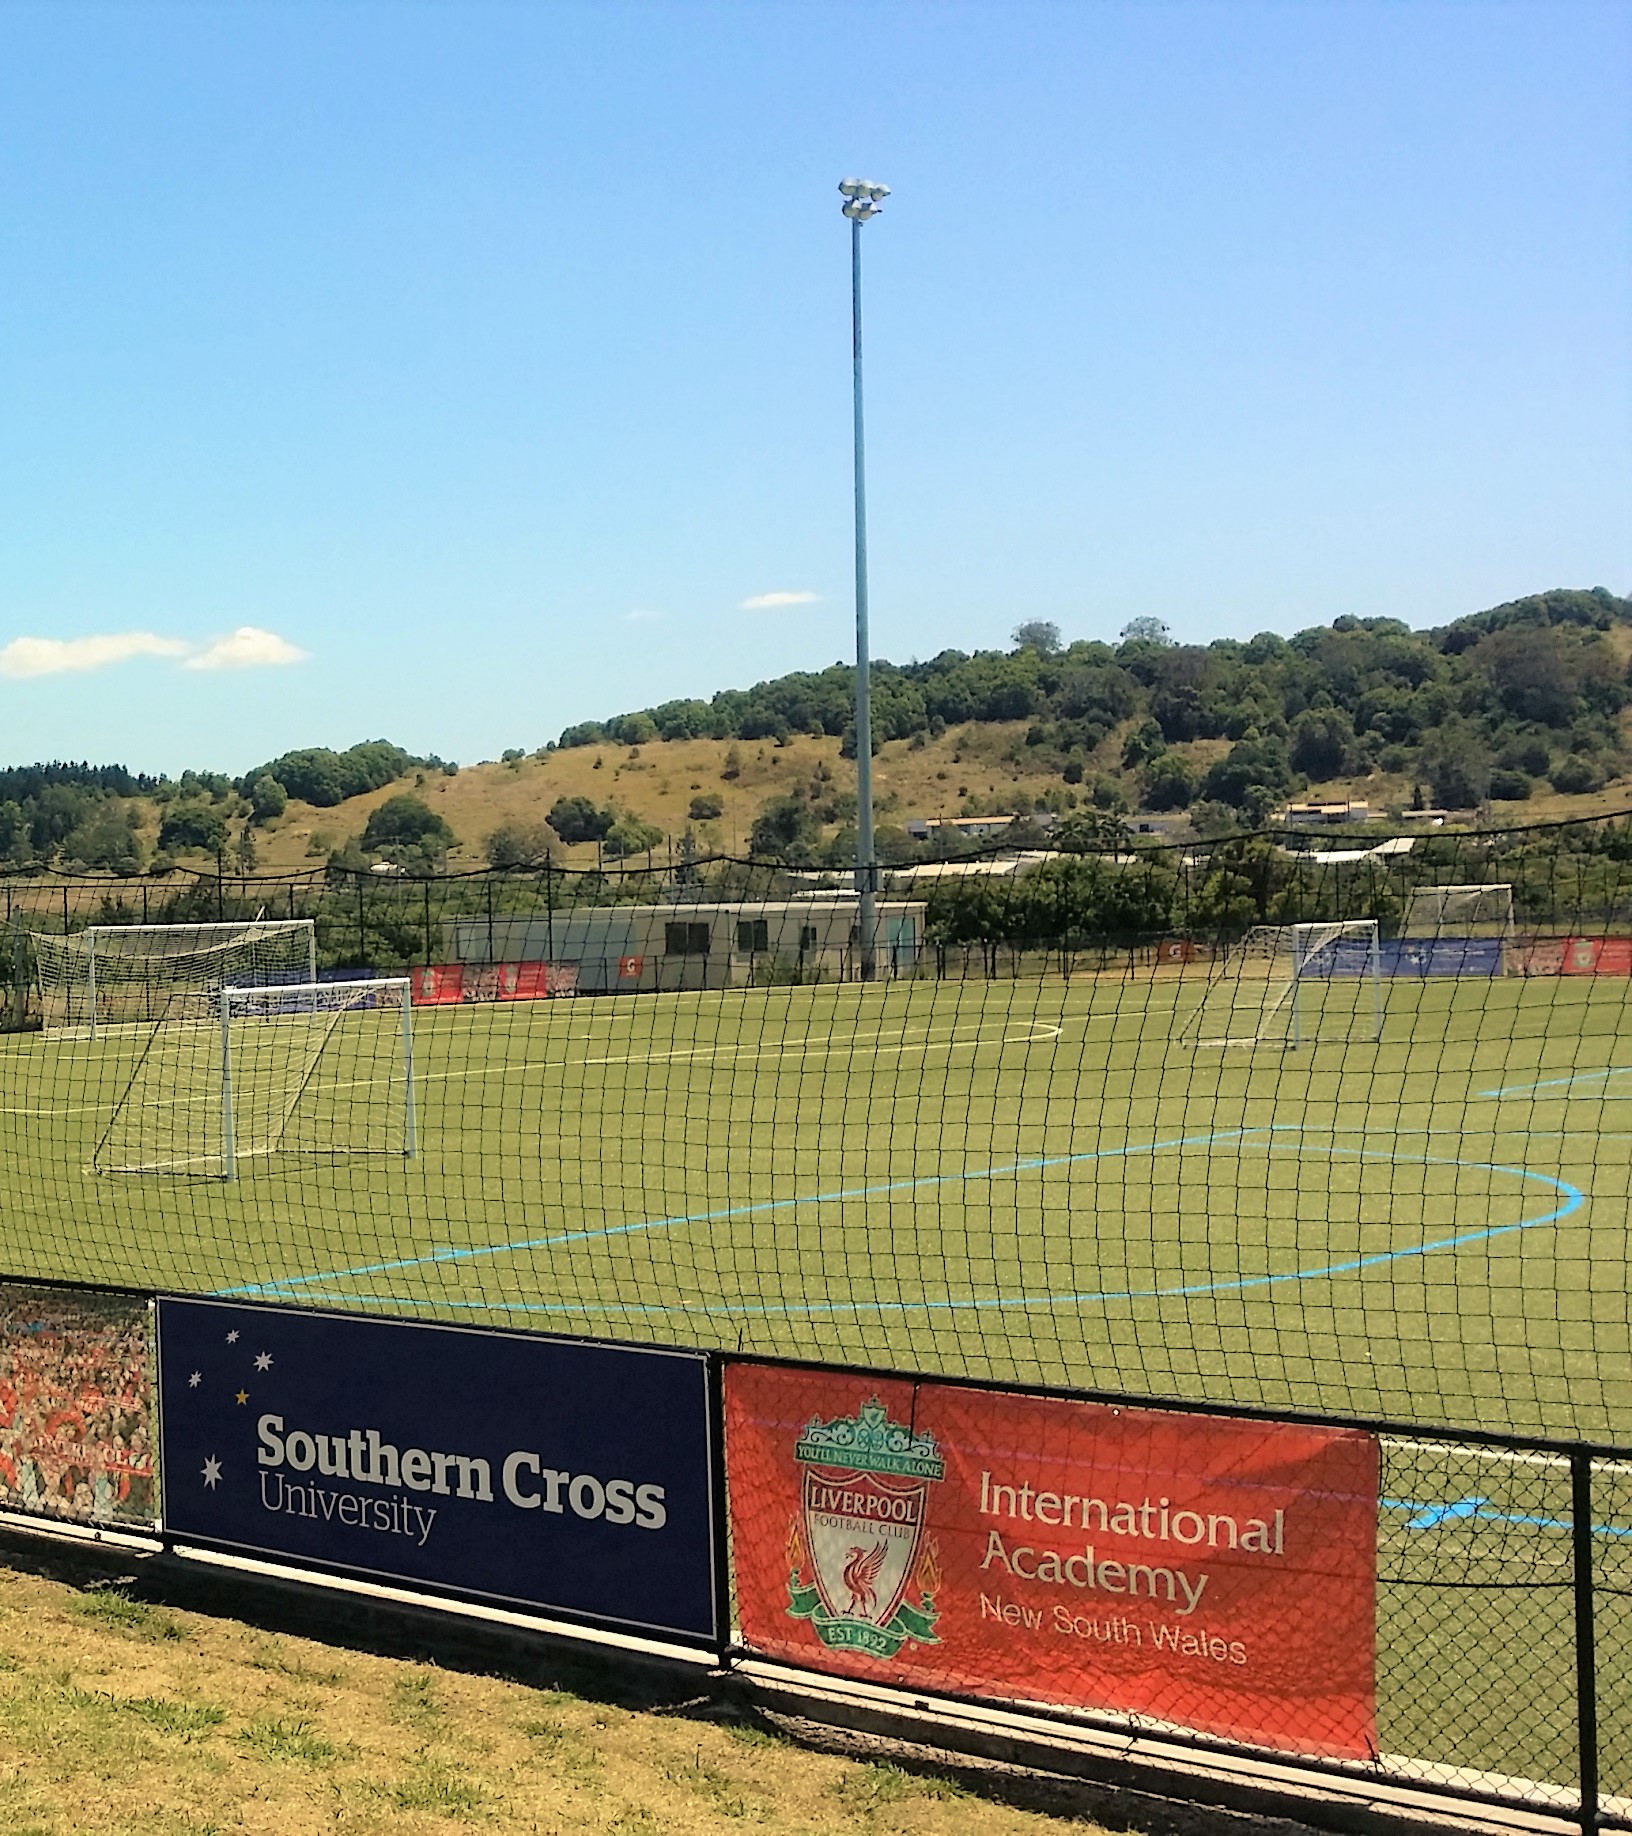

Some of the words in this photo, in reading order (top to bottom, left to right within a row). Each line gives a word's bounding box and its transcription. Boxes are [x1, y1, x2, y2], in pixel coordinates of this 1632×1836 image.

[257, 1413, 494, 1502] Southern
[502, 1450, 667, 1529] Cross
[833, 1450, 868, 1466] NEVER
[869, 1454, 900, 1471] WALK
[902, 1459, 942, 1477] ALONE
[258, 1470, 437, 1546] University
[810, 1485, 917, 1523] LIVERPOOL
[814, 1514, 874, 1534] FOOTBALL
[879, 1523, 911, 1539] CLUB
[979, 1471, 1284, 1555] International
[979, 1529, 1209, 1616] Academy
[828, 1626, 852, 1642] EST
[857, 1630, 887, 1651] 1892
[979, 1591, 1043, 1631] New
[1053, 1604, 1142, 1647] South
[1150, 1620, 1248, 1666] Wales
